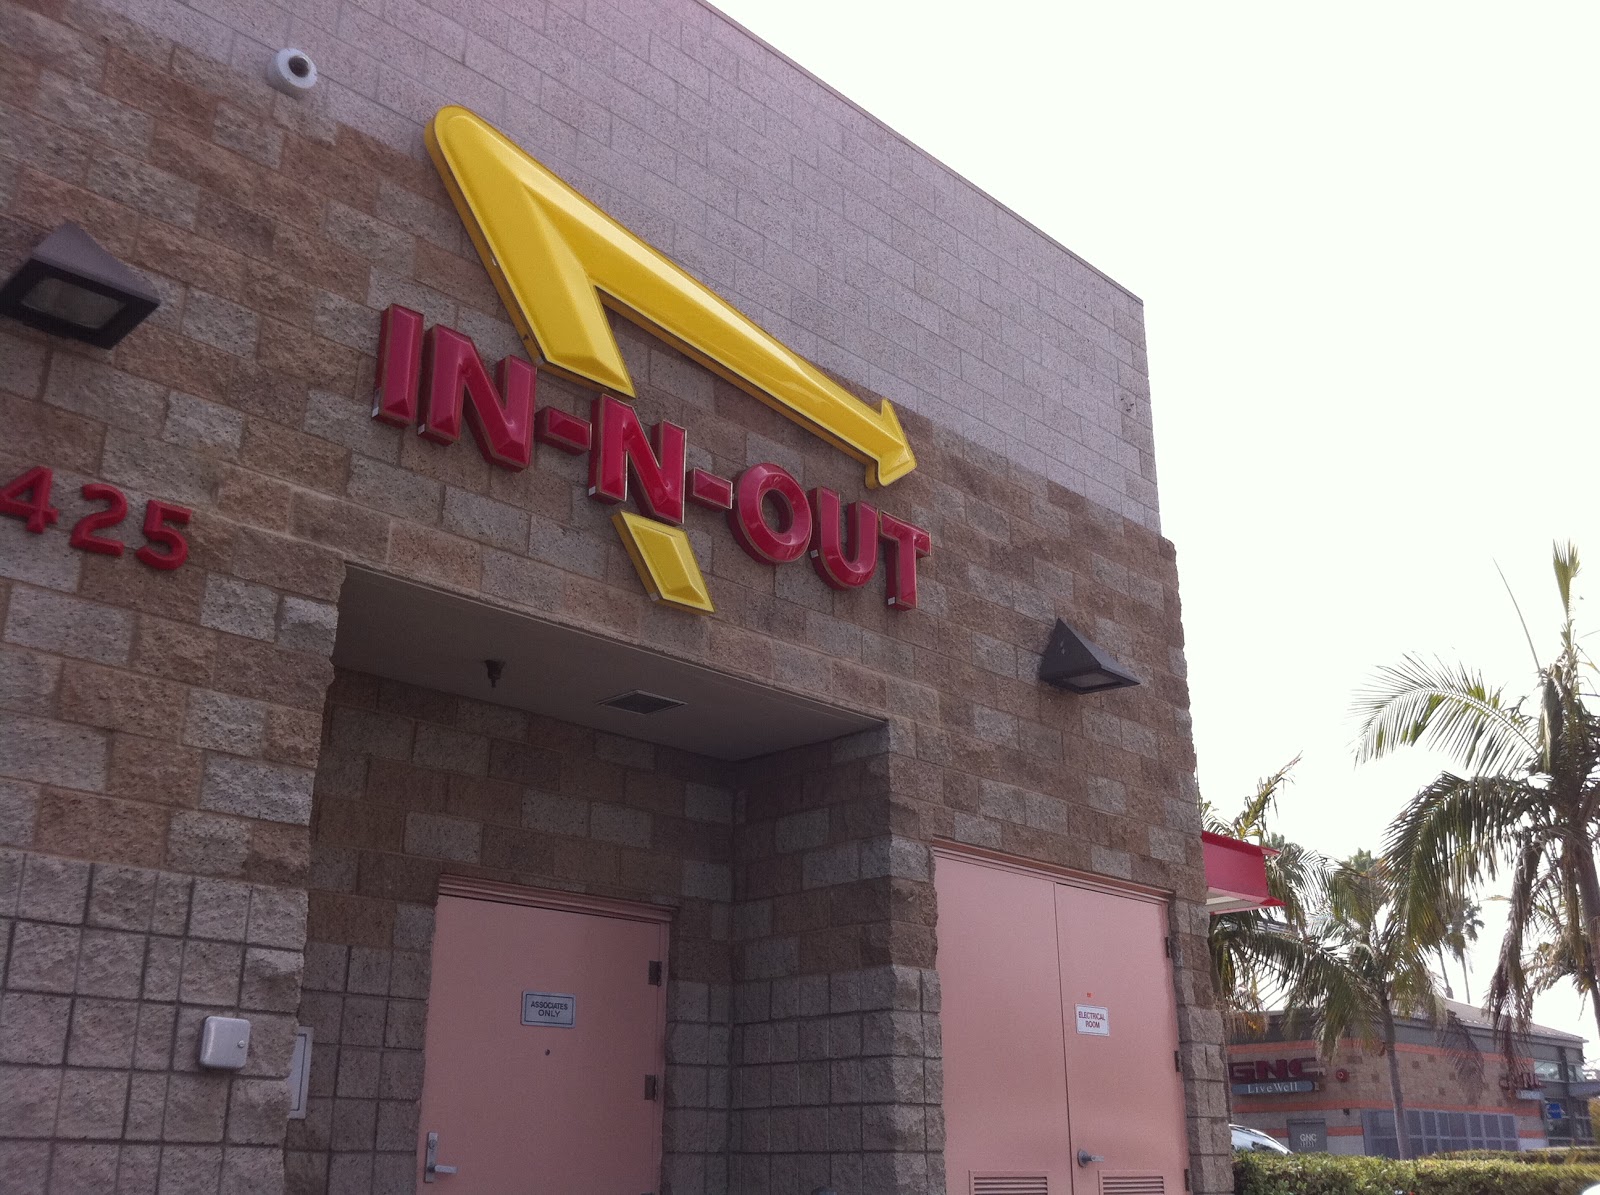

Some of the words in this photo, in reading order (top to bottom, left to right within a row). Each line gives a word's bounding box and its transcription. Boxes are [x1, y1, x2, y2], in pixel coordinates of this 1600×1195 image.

[372, 303, 931, 612] IN-N-OUT
[0, 465, 192, 571] 425
[530, 1001, 568, 1010] ASSOCIATES
[538, 1009, 561, 1018] ONLY
[1078, 1011, 1105, 1020] ELECTRICAL
[1085, 1020, 1100, 1028] ROOM
[1229, 1057, 1325, 1083] GNC
[1299, 1133, 1317, 1142] GNC
